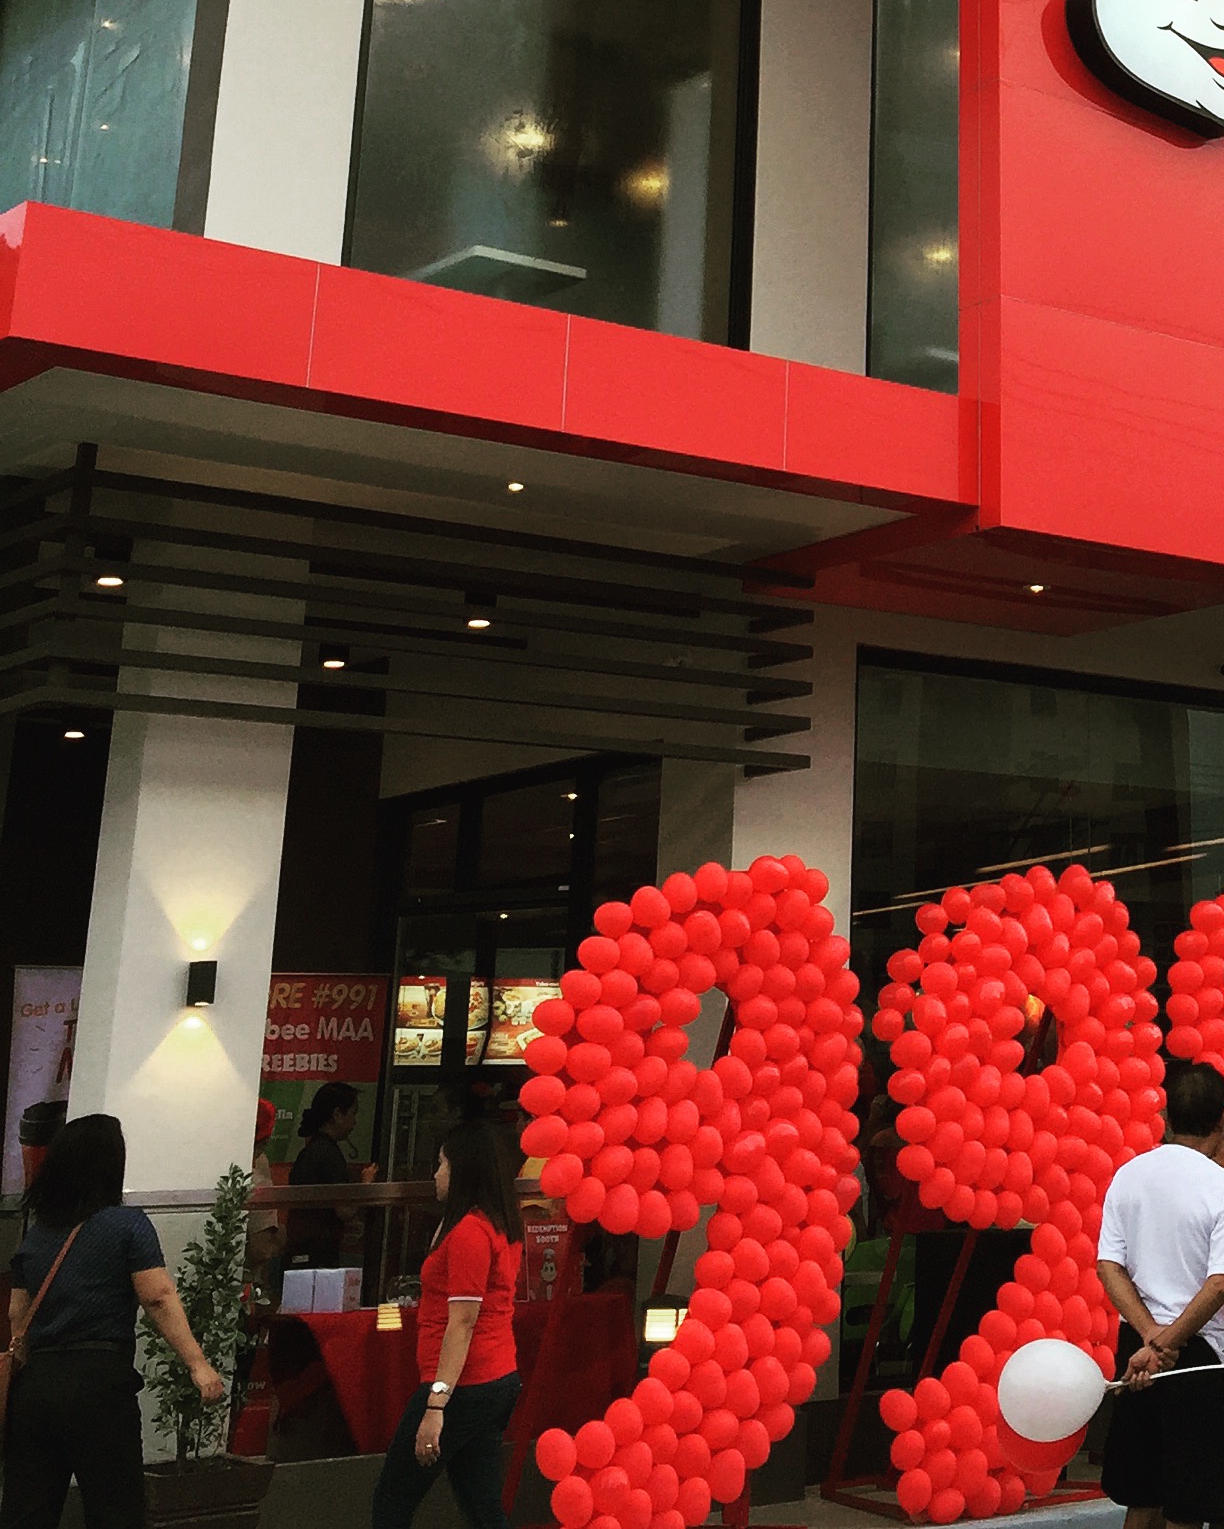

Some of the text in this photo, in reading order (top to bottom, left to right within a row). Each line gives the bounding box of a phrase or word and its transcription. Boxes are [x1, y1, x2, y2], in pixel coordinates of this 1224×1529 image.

[312, 983, 379, 1011] #991
[20, 1002, 50, 1017] Get
[54, 1003, 66, 1014] a
[317, 1016, 373, 1041] MAA
[261, 1053, 338, 1073] REEBIES
